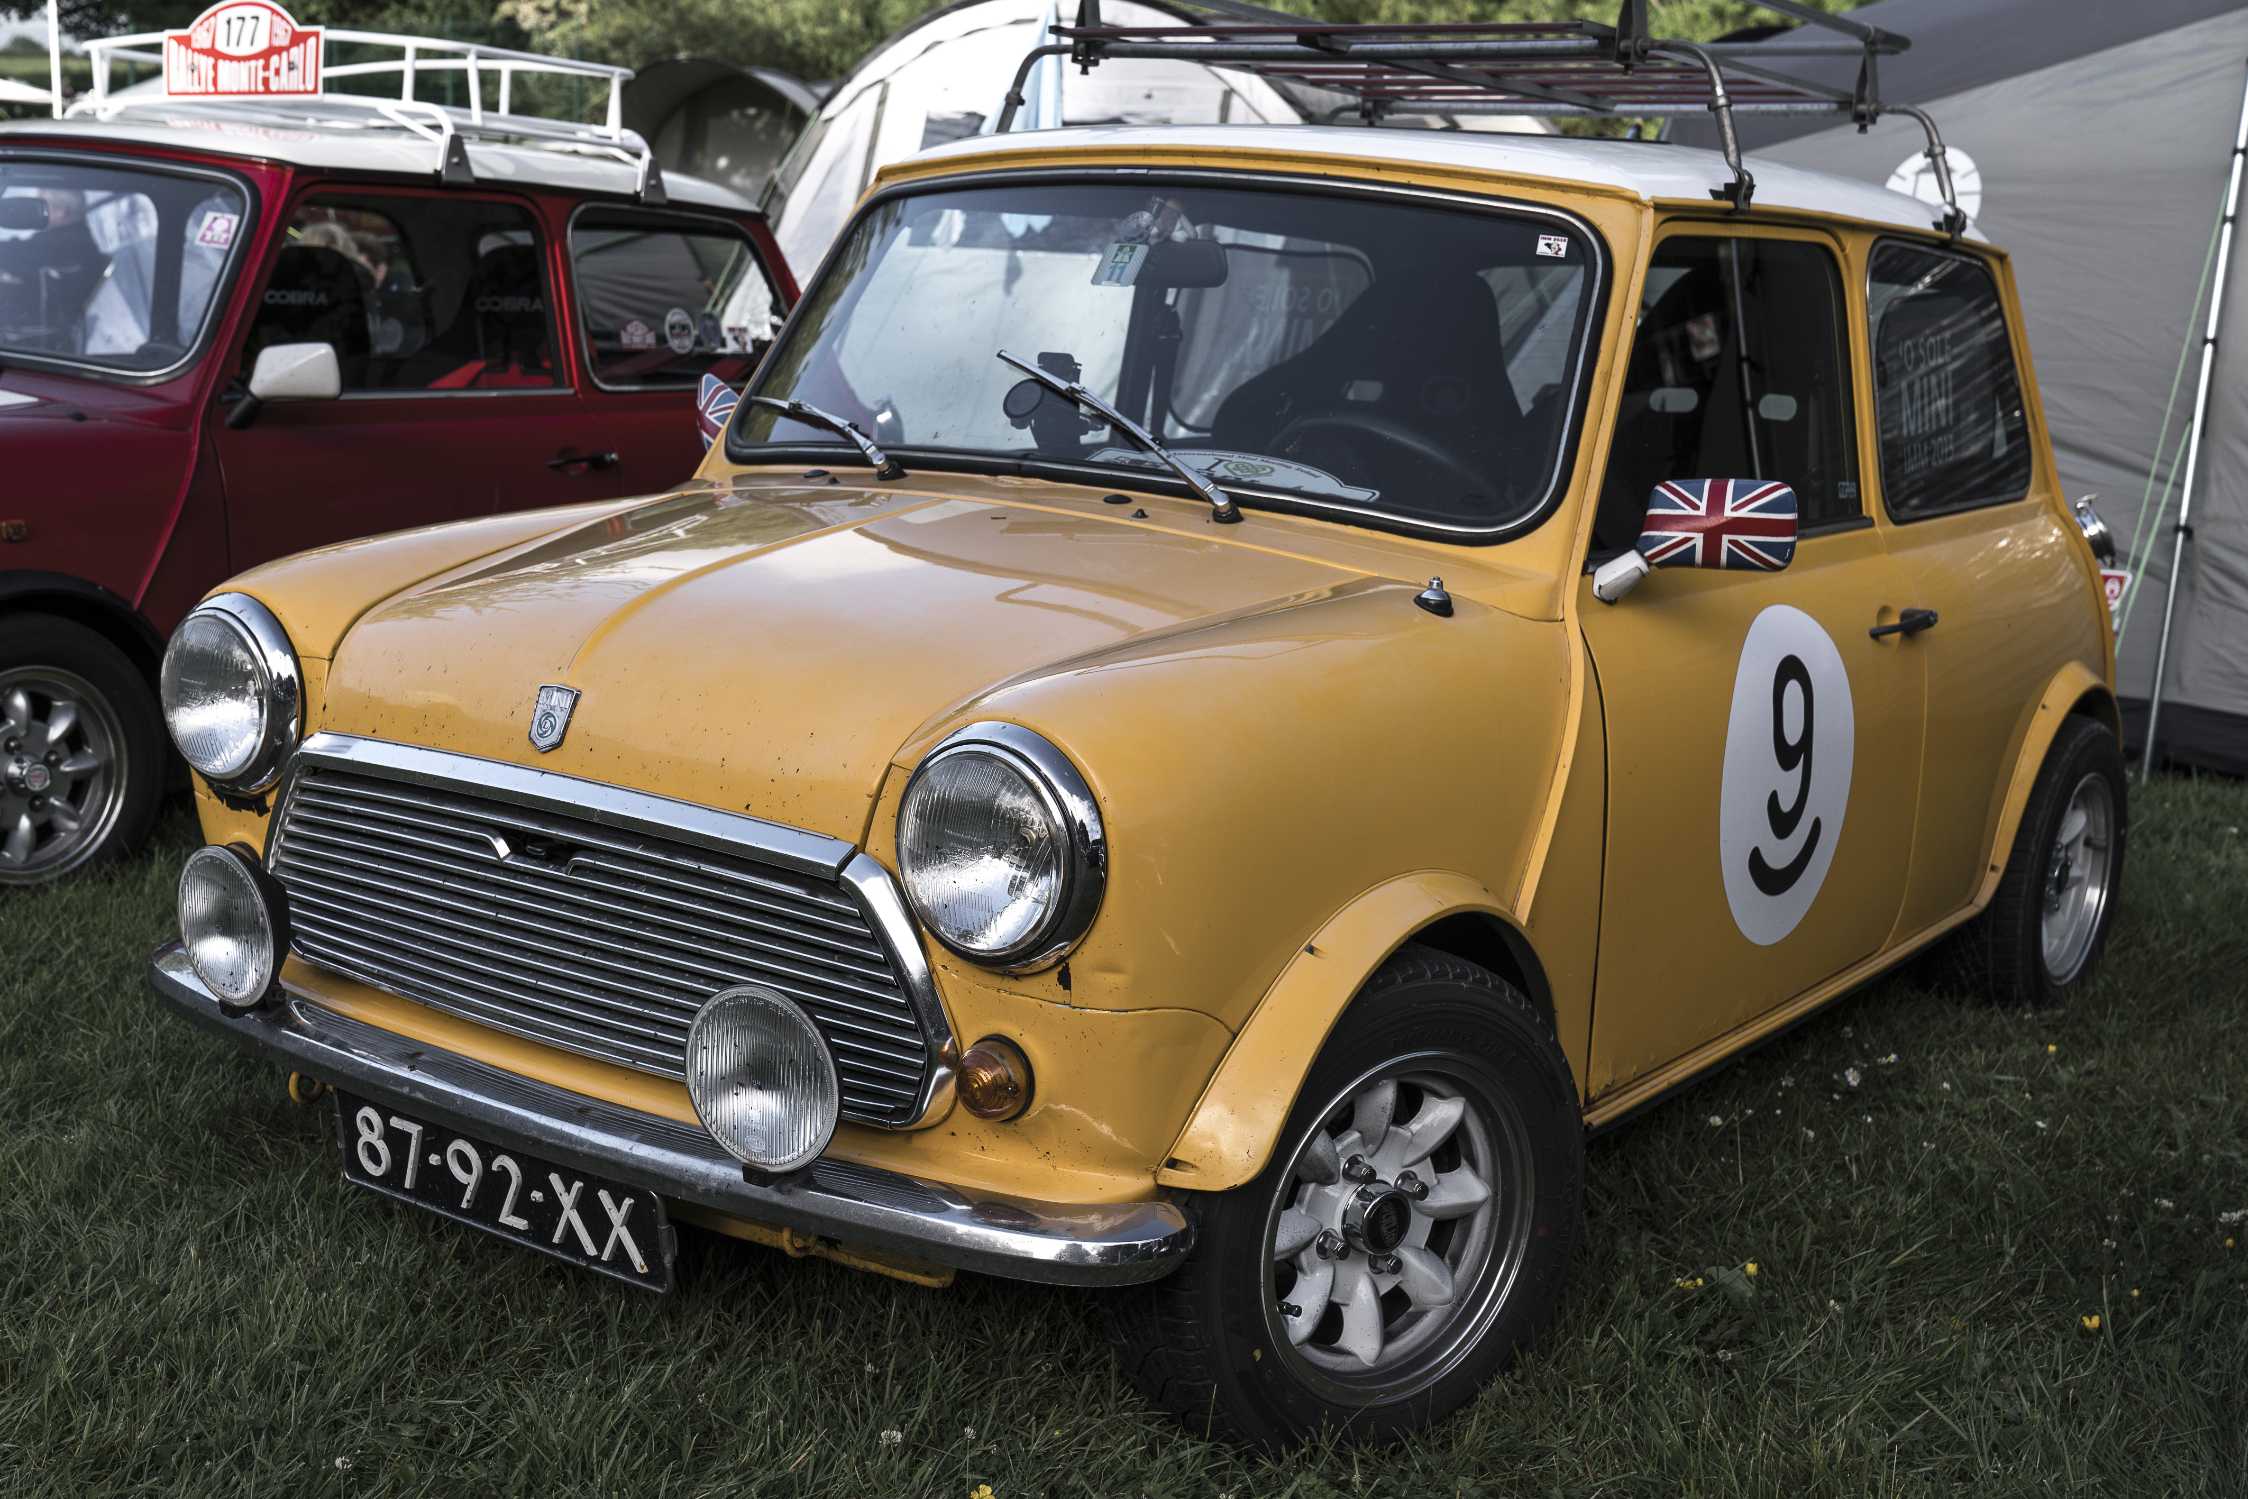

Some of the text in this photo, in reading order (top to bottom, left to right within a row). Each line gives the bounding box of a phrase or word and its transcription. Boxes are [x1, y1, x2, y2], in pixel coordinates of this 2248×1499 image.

[225, 16, 260, 47] 177
[168, 36, 317, 93] RALLYE MONTE-CARLO
[264, 289, 328, 305] COBRA
[475, 296, 544, 312] COBRA
[1901, 370, 1953, 436] MINI
[539, 688, 572, 709] MINI
[1767, 654, 1814, 840] 9
[356, 1106, 648, 1274] 87-92-XX
